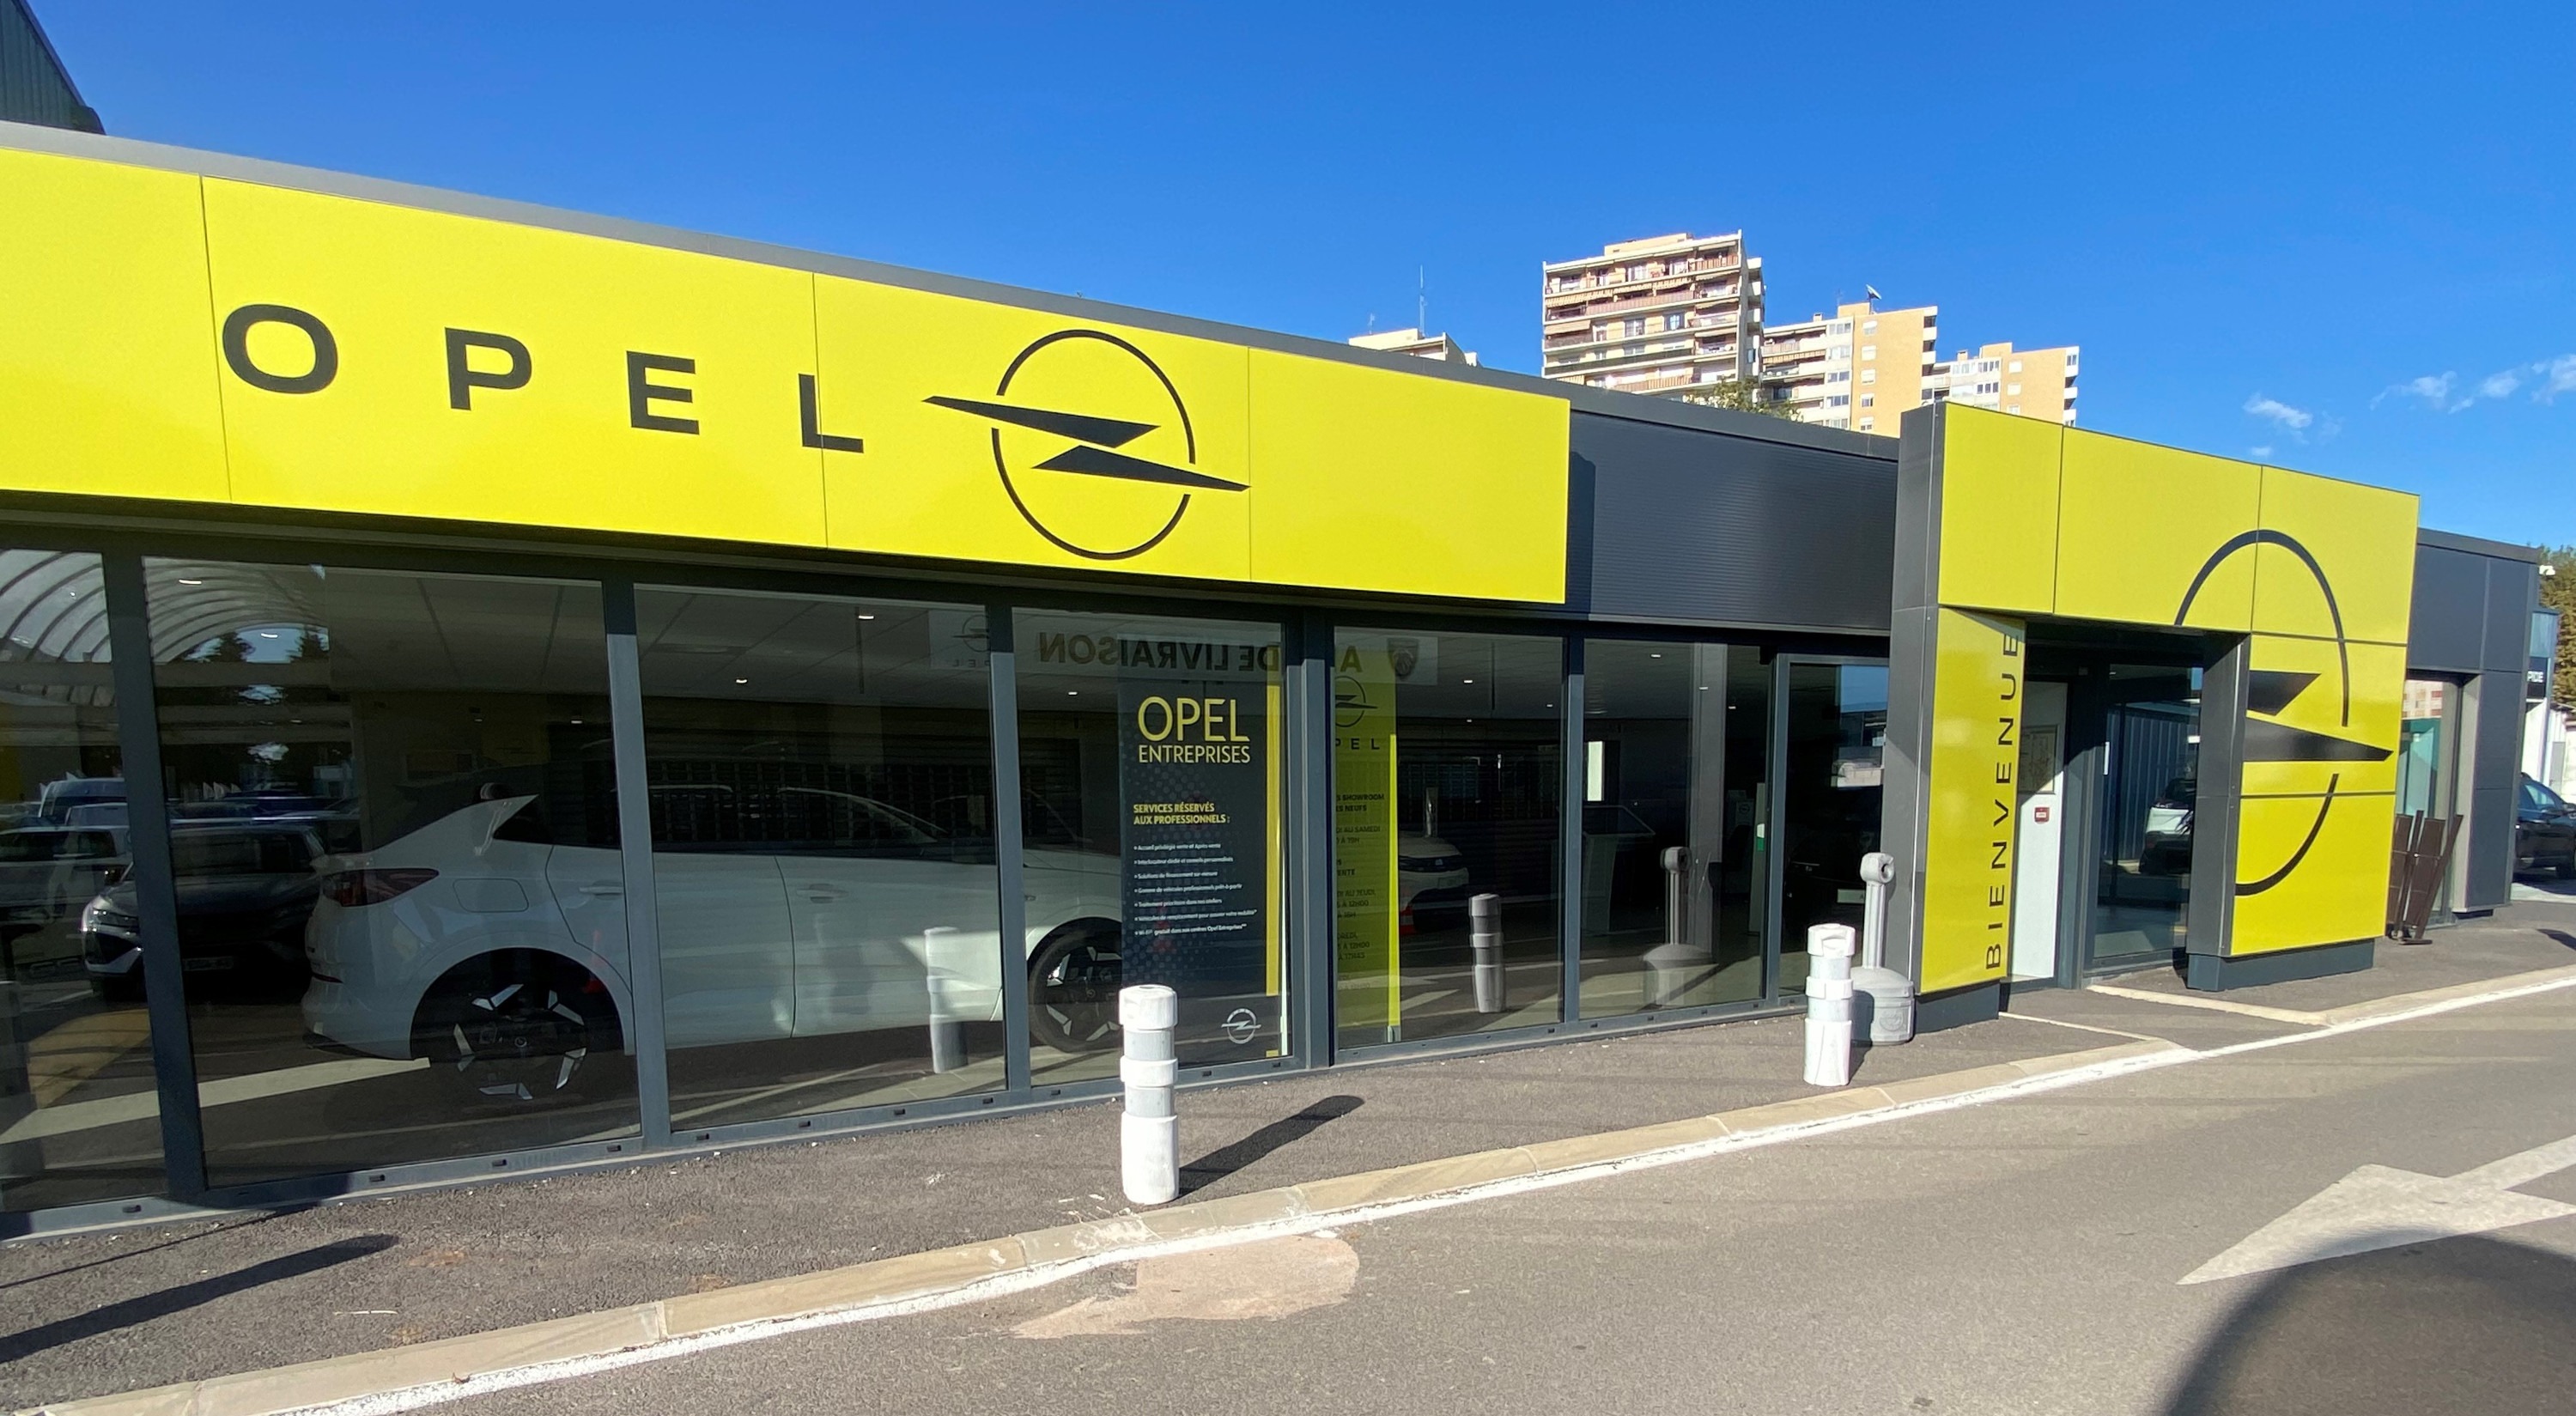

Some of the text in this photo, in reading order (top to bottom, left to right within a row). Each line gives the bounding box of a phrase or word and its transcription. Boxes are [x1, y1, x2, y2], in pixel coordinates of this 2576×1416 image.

[222, 303, 864, 454] OPEL
[1138, 696, 1250, 742] OPEL
[1139, 744, 1251, 763] ENTREPRISES
[1335, 738, 1380, 751] PEL
[1133, 801, 1215, 813] SERVICES RÉSERVÉS
[1985, 633, 2020, 970] BIENVENUE
[1133, 815, 1152, 824] AUX
